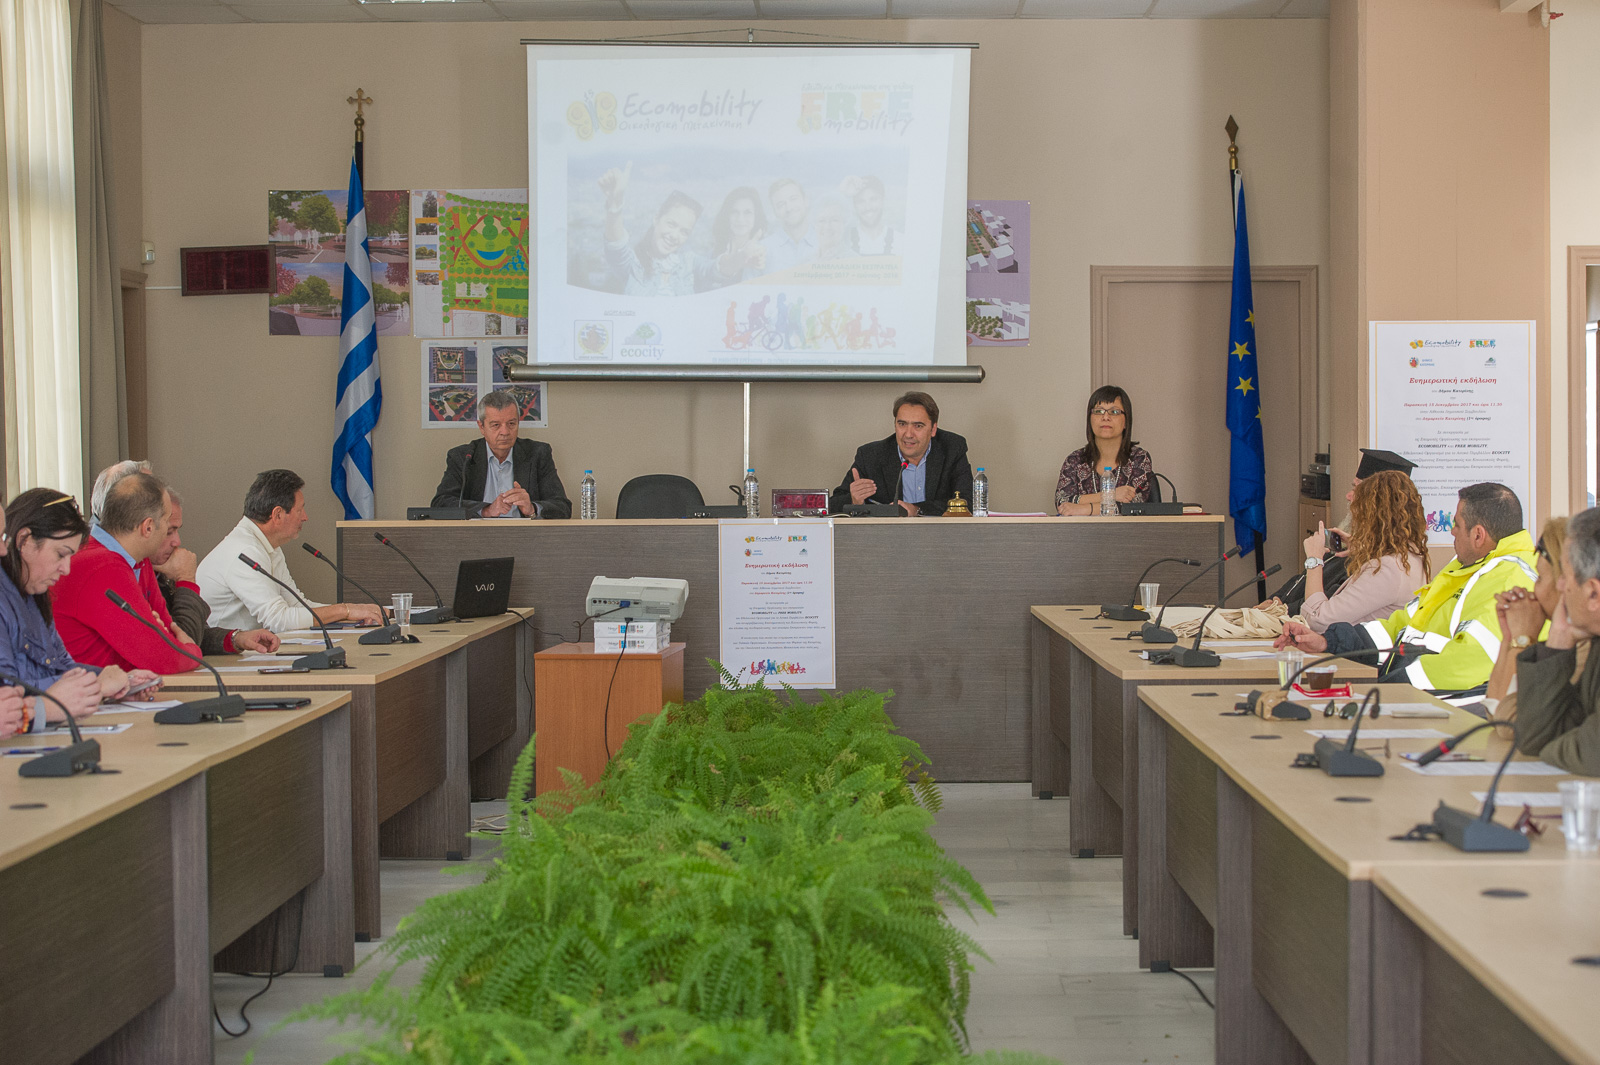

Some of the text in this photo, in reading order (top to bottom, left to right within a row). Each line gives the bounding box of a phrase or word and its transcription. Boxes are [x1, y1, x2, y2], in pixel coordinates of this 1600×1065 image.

[622, 88, 763, 125] Ecomobility
[824, 111, 914, 136] mobility
[620, 345, 665, 360] ecocity
[1460, 377, 1497, 385] εκδήλωση
[475, 582, 495, 592] VAIO
